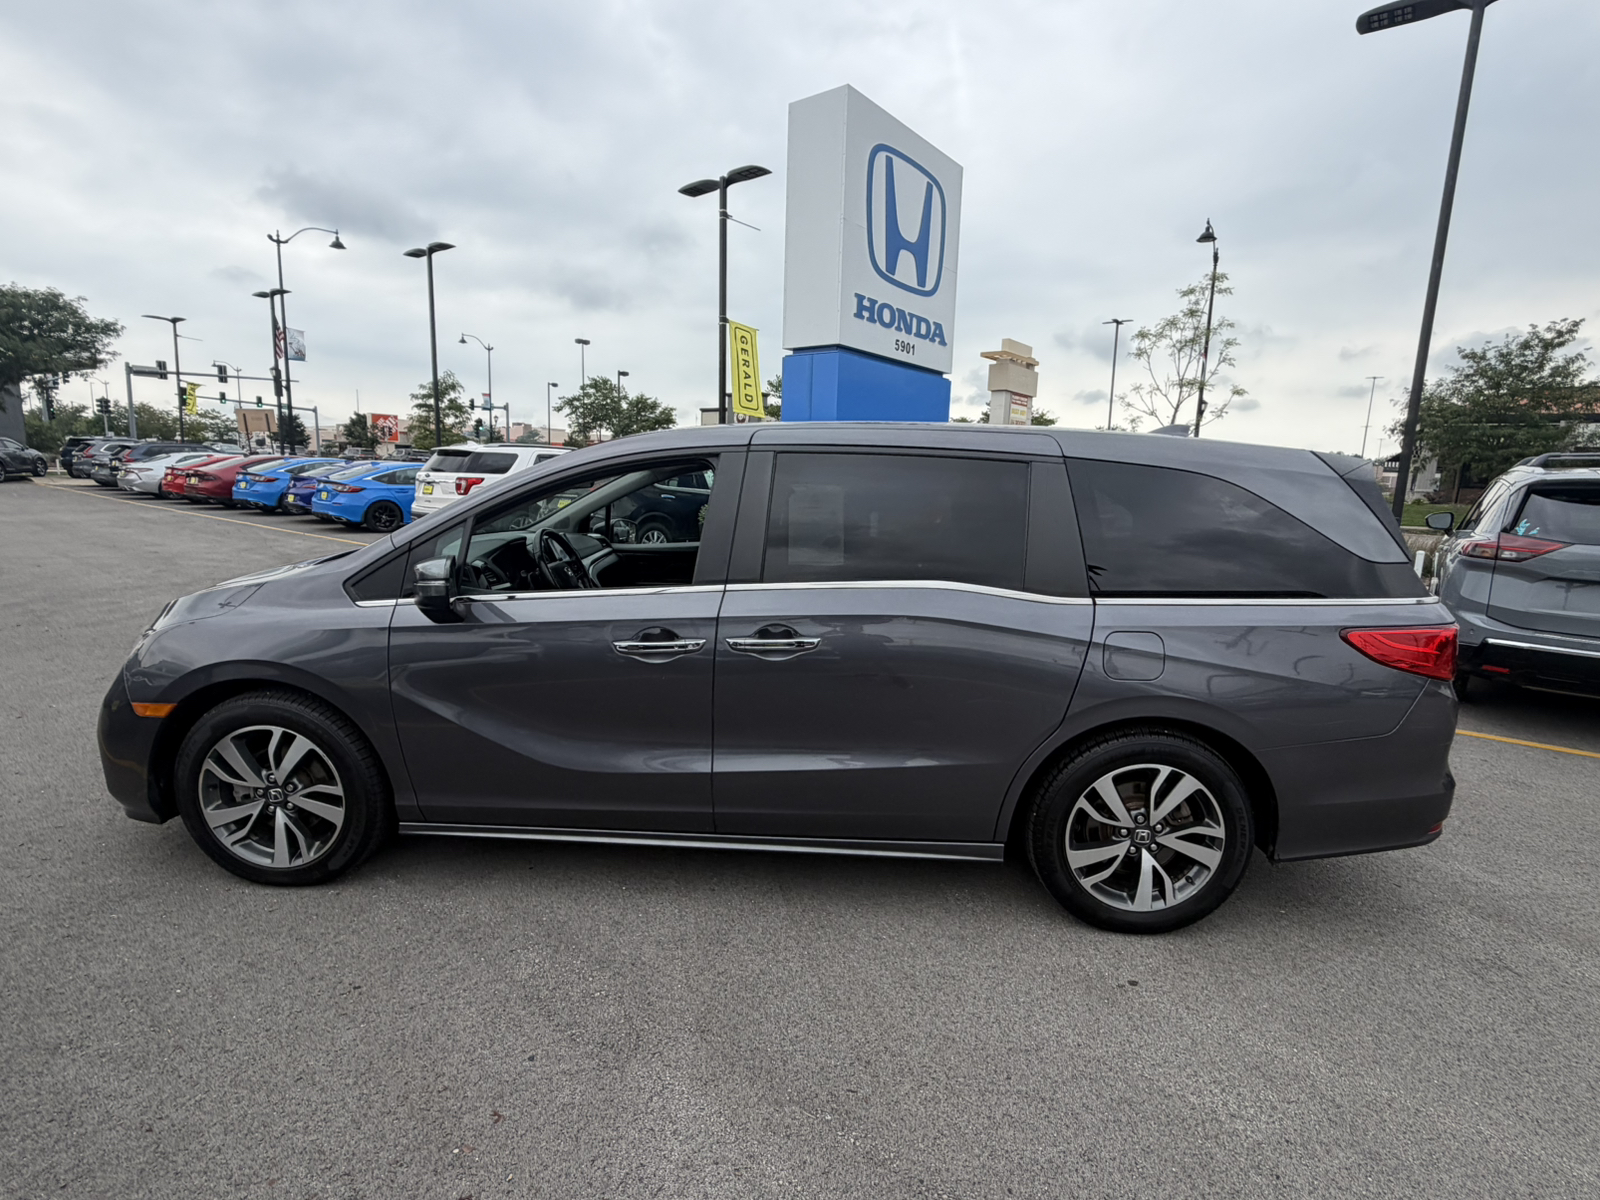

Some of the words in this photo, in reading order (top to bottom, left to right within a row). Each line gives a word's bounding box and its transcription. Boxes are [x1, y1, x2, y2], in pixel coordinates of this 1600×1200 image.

[853, 292, 947, 347] HONDA
[740, 335, 754, 403] GERALD
[894, 339, 915, 356] 5901
